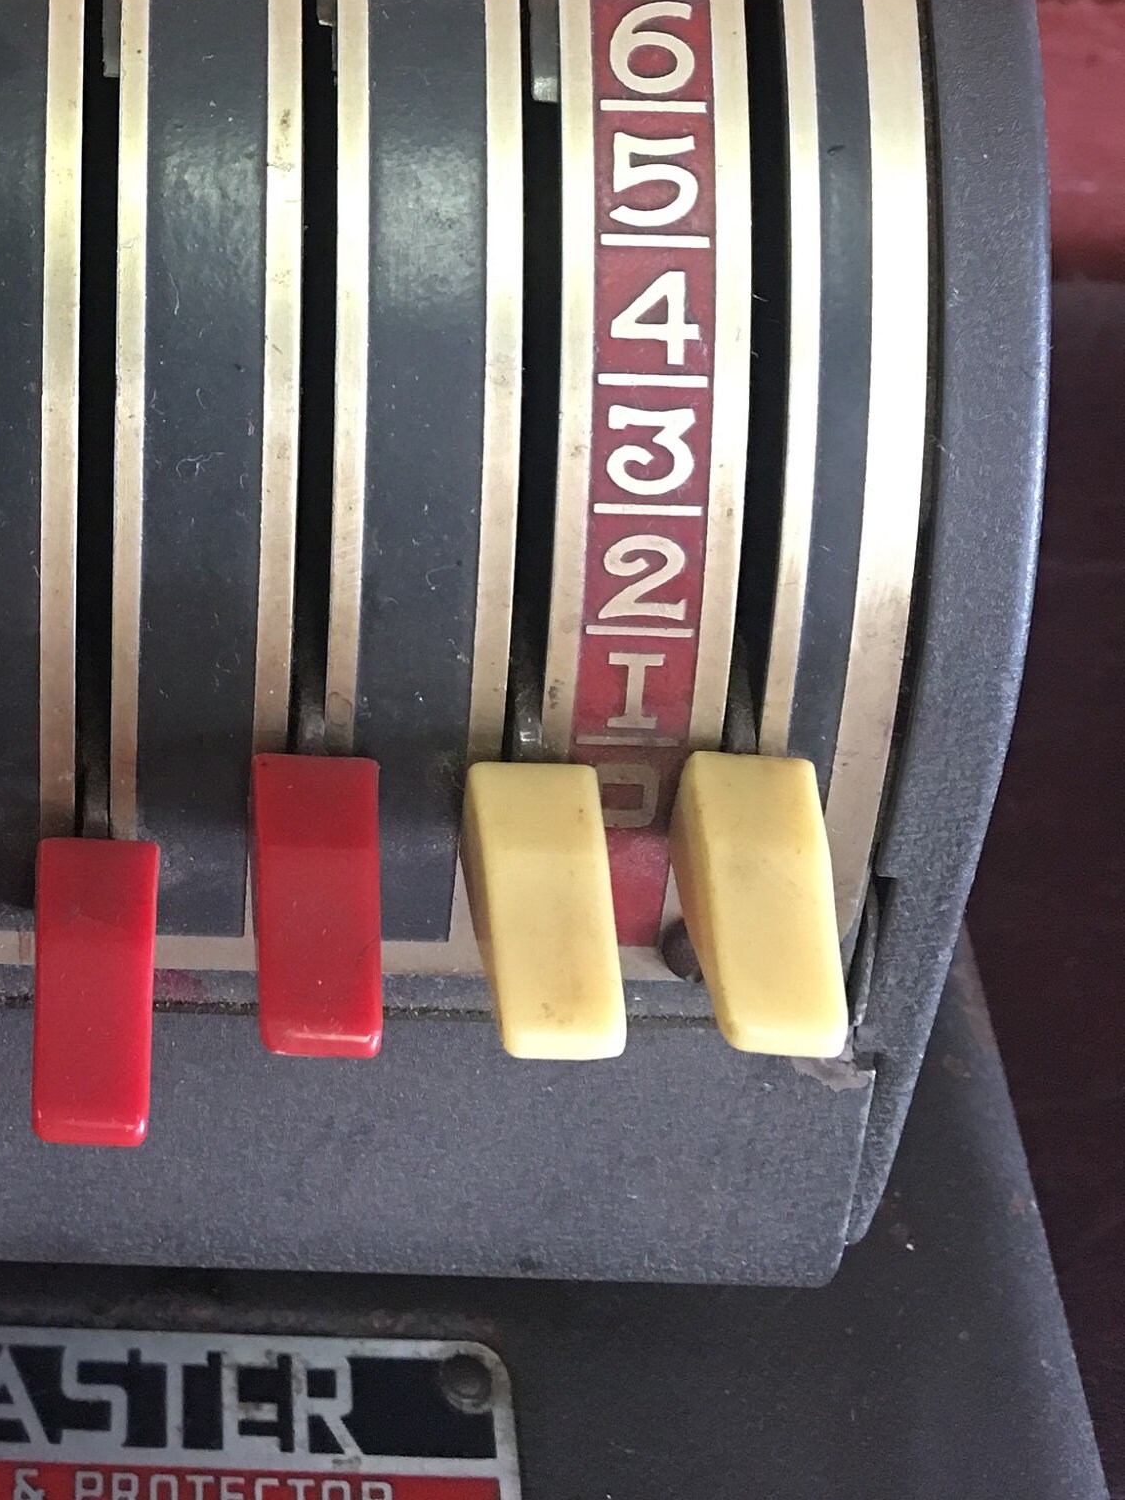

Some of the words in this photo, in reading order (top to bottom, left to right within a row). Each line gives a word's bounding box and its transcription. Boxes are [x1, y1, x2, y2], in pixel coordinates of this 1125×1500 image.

[609, 1, 695, 94] 6
[609, 131, 699, 227] 5
[611, 271, 700, 365] 4
[606, 404, 696, 496] 3
[597, 534, 687, 621] 2
